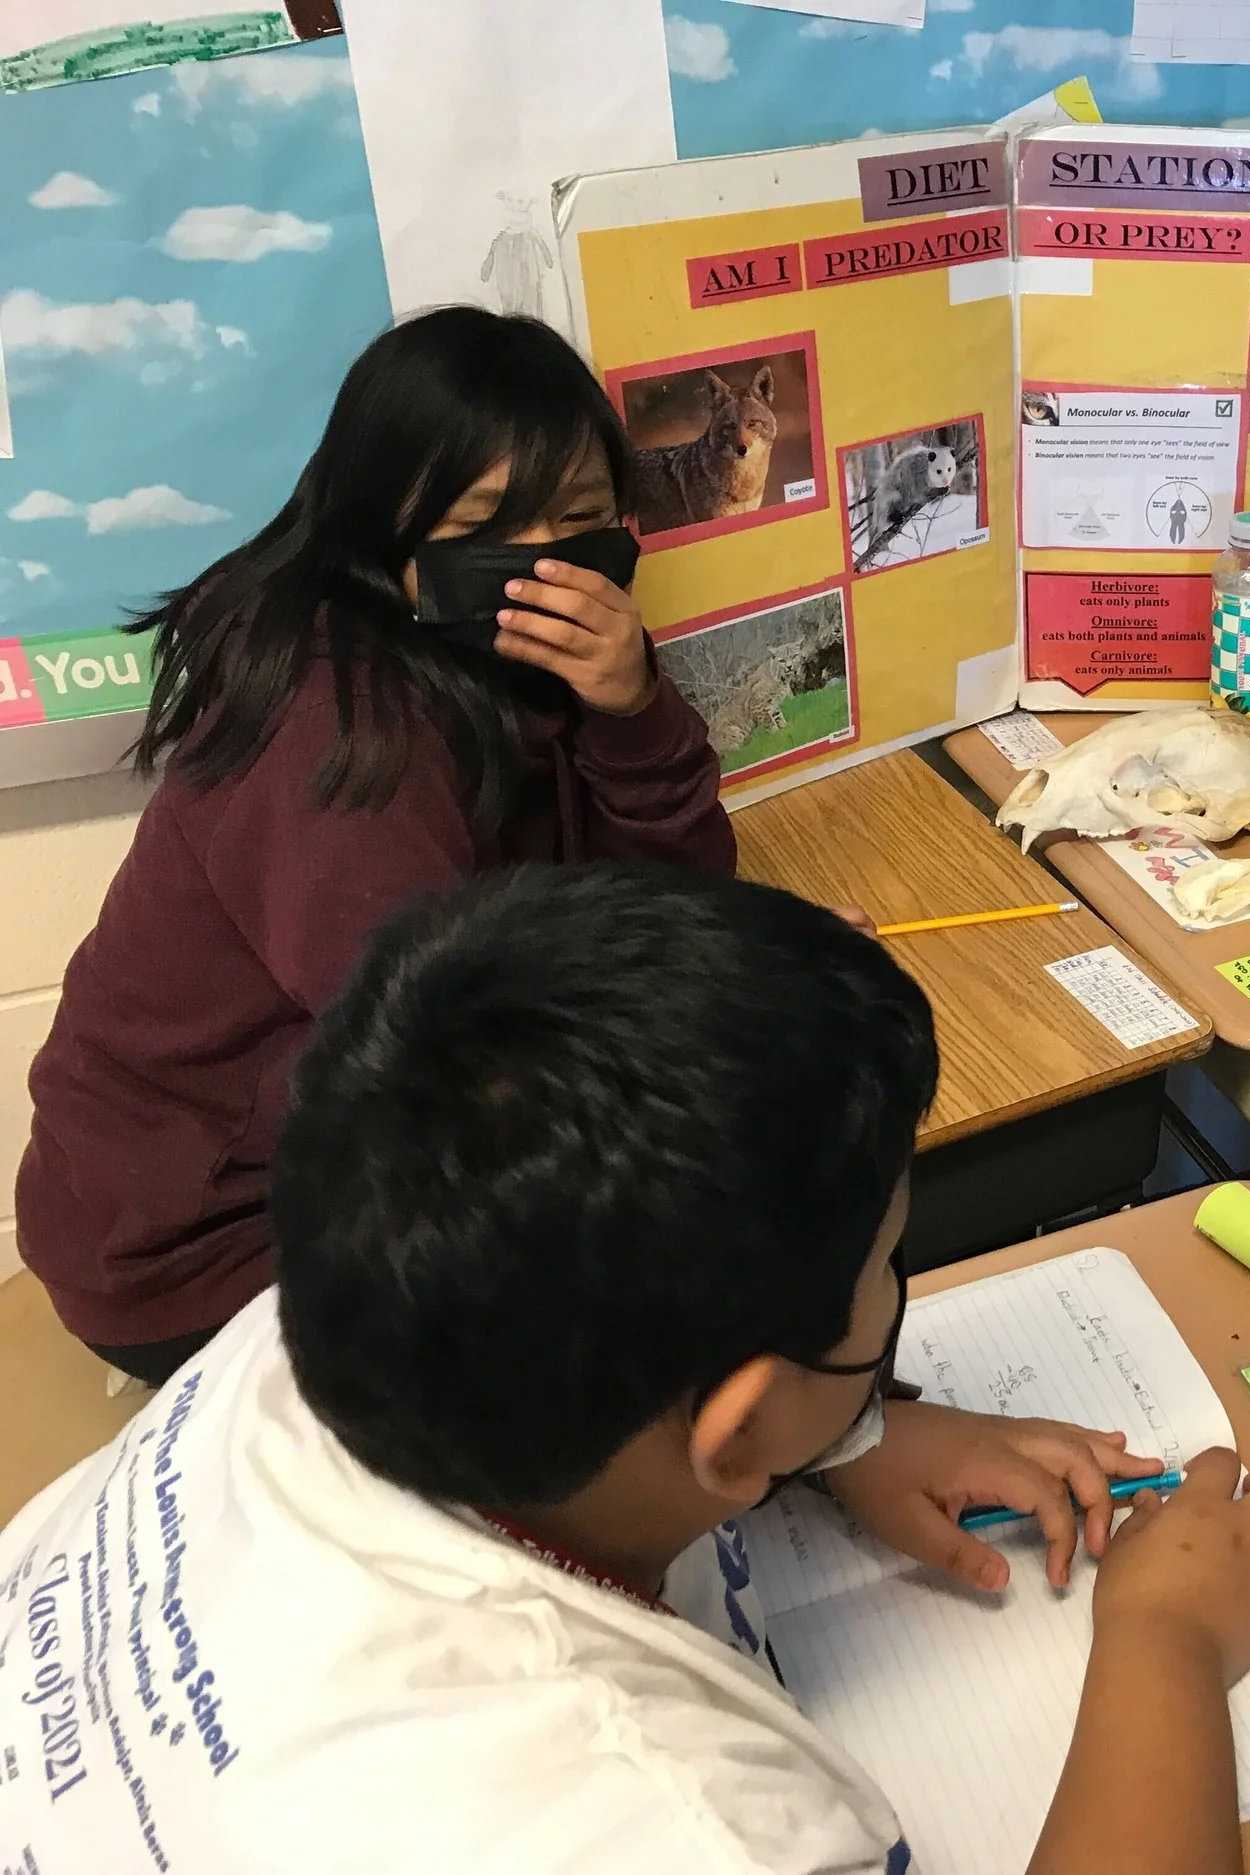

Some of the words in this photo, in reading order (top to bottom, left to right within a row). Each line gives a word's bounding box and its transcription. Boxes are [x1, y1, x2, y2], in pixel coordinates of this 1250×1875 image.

[885, 158, 990, 201] DIET
[1054, 221, 1107, 247] OR
[1121, 225, 1242, 251] PREY?
[703, 260, 757, 292] AM
[774, 256, 789, 281] I
[823, 224, 1003, 277] PREDATOR
[1067, 407, 1123, 418] Monocular
[1125, 409, 1139, 418] vs.
[1141, 407, 1190, 419] Binocular
[789, 483, 814, 497] Coyote
[959, 532, 986, 546] Opossum
[1091, 581, 1159, 595] Herbivore:
[1079, 597, 1104, 607] eats
[1106, 596, 1132, 609] only
[1134, 596, 1170, 609] plants
[1091, 616, 1158, 629] Omnivore:
[1042, 632, 1065, 642] eats
[1068, 631, 1094, 642] both
[1097, 631, 1132, 644] plants
[1136, 631, 1158, 641] and
[1161, 631, 1206, 641] animals
[1090, 650, 1158, 663] Carnivore:
[34, 651, 140, 694] You
[1075, 665, 1096, 675] eats
[1100, 664, 1125, 677] only
[1128, 664, 1173, 675] animals
[26, 1553, 69, 1660] Class
[155, 1472, 185, 1548] Louis
[186, 1670, 239, 1777] School
[22, 1662, 72, 1700] of
[38, 1696, 90, 1805] 2021
